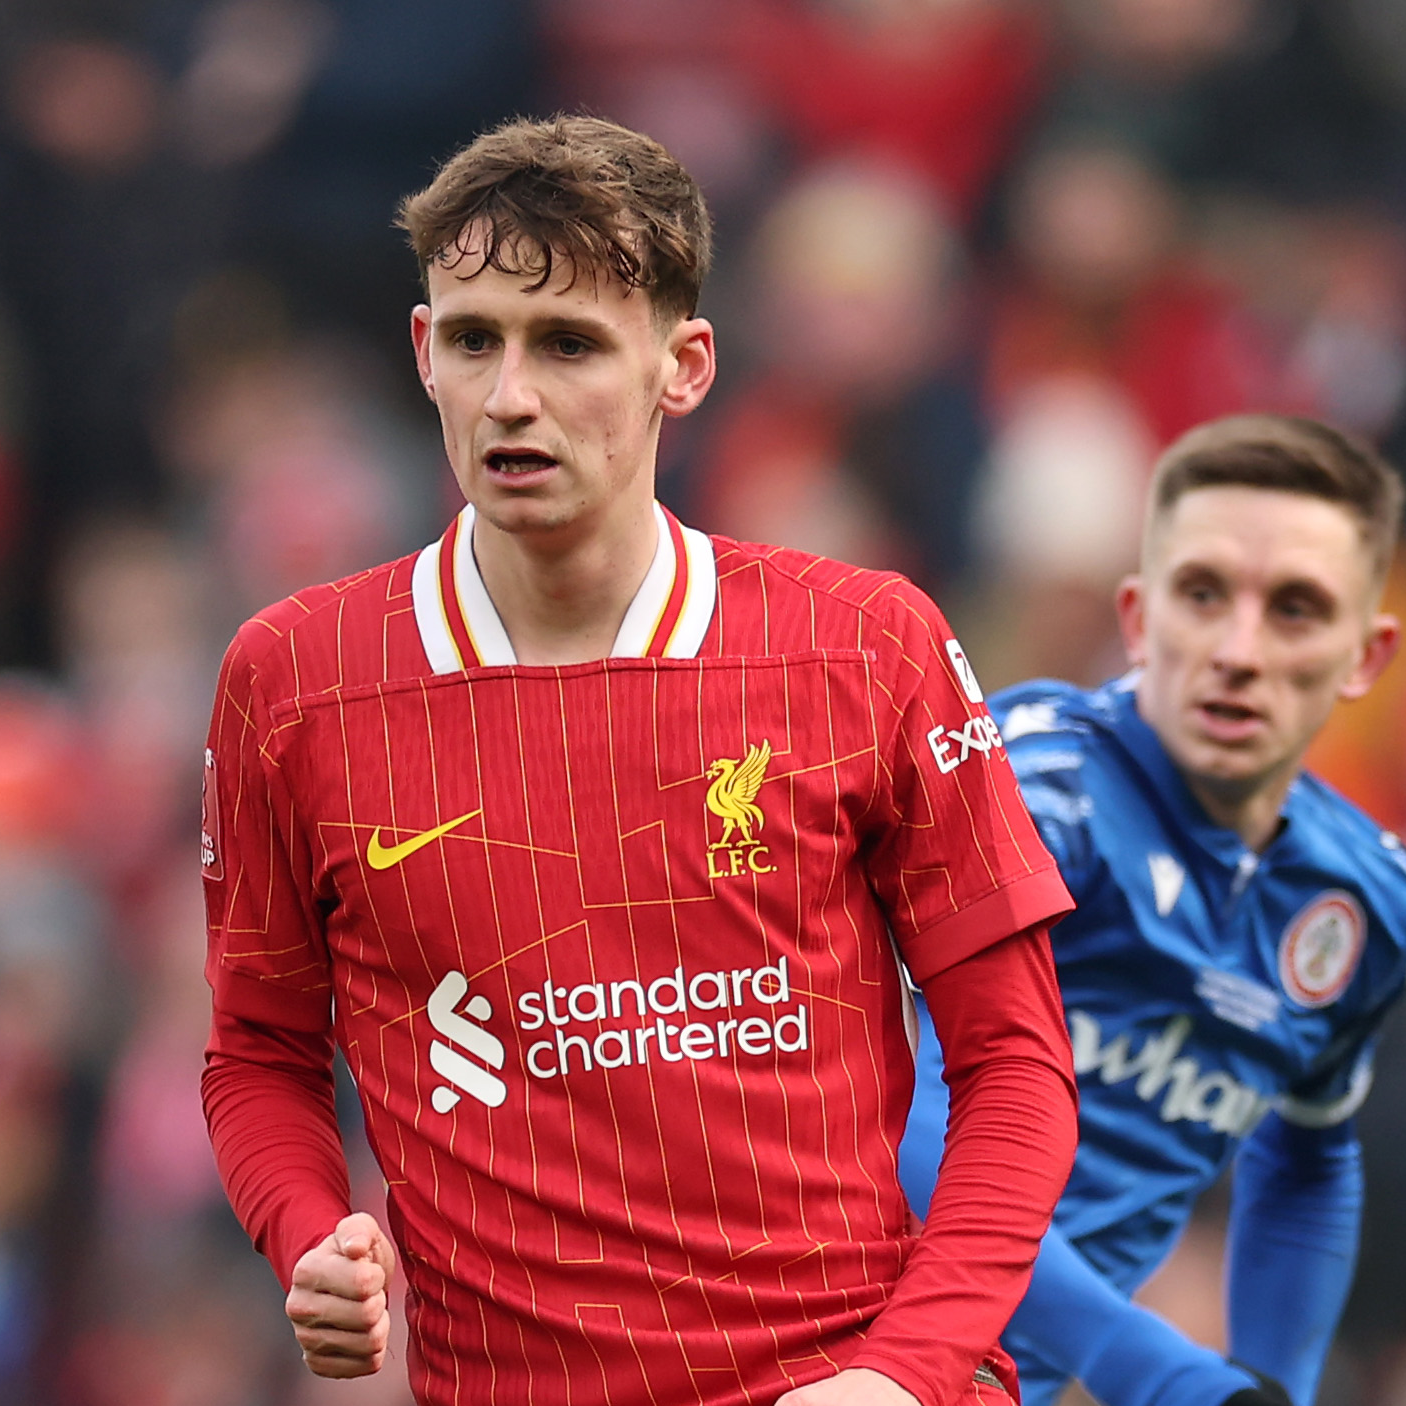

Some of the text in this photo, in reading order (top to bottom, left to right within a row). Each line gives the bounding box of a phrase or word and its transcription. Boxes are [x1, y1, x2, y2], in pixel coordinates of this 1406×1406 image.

[926, 714, 1004, 775] Expe
[707, 846, 778, 879] L.F.C.
[517, 955, 791, 1031] standard
[526, 1004, 809, 1080] chartered
